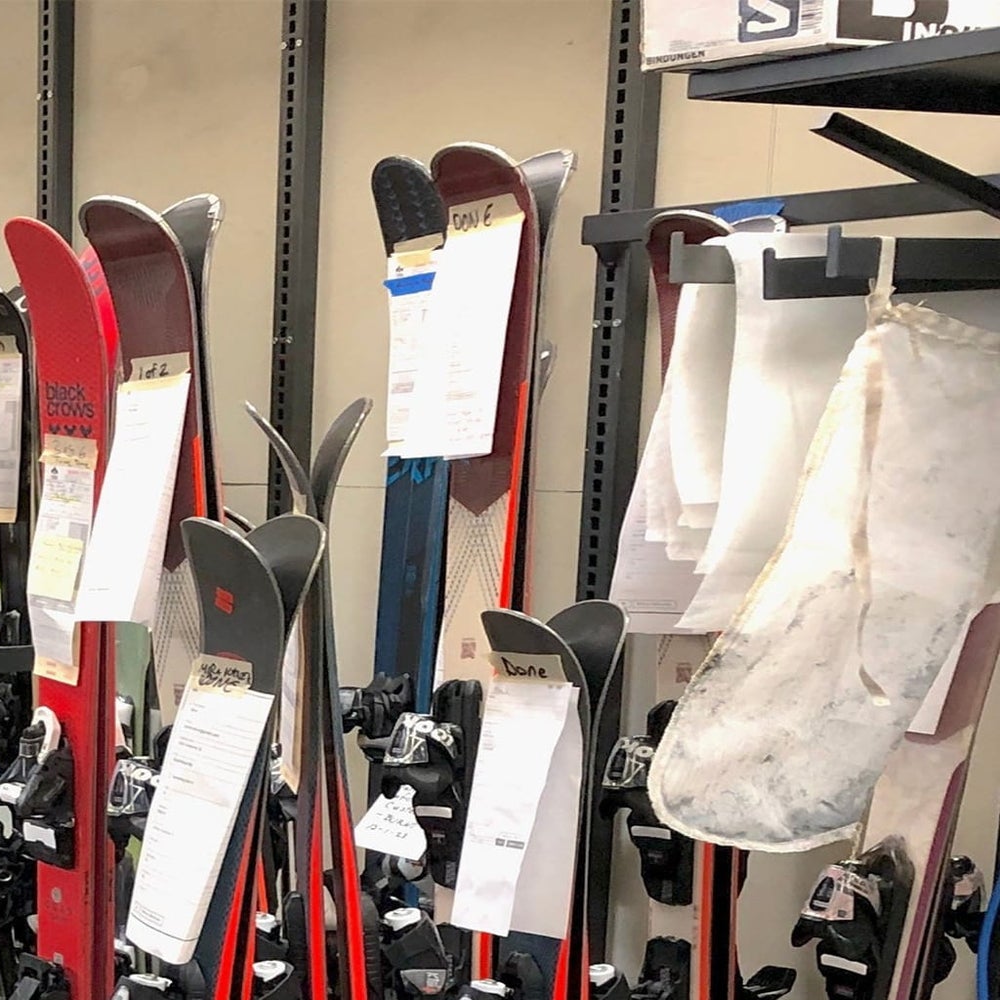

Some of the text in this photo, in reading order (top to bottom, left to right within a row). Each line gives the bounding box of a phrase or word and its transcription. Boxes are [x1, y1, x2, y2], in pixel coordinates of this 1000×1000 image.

[646, 50, 705, 66] BINDUNGEN
[452, 203, 494, 232] DONE
[145, 364, 159, 379] of
[159, 363, 169, 376] 2
[45, 381, 85, 401] black
[46, 402, 94, 418] crows
[501, 656, 549, 678] Done
